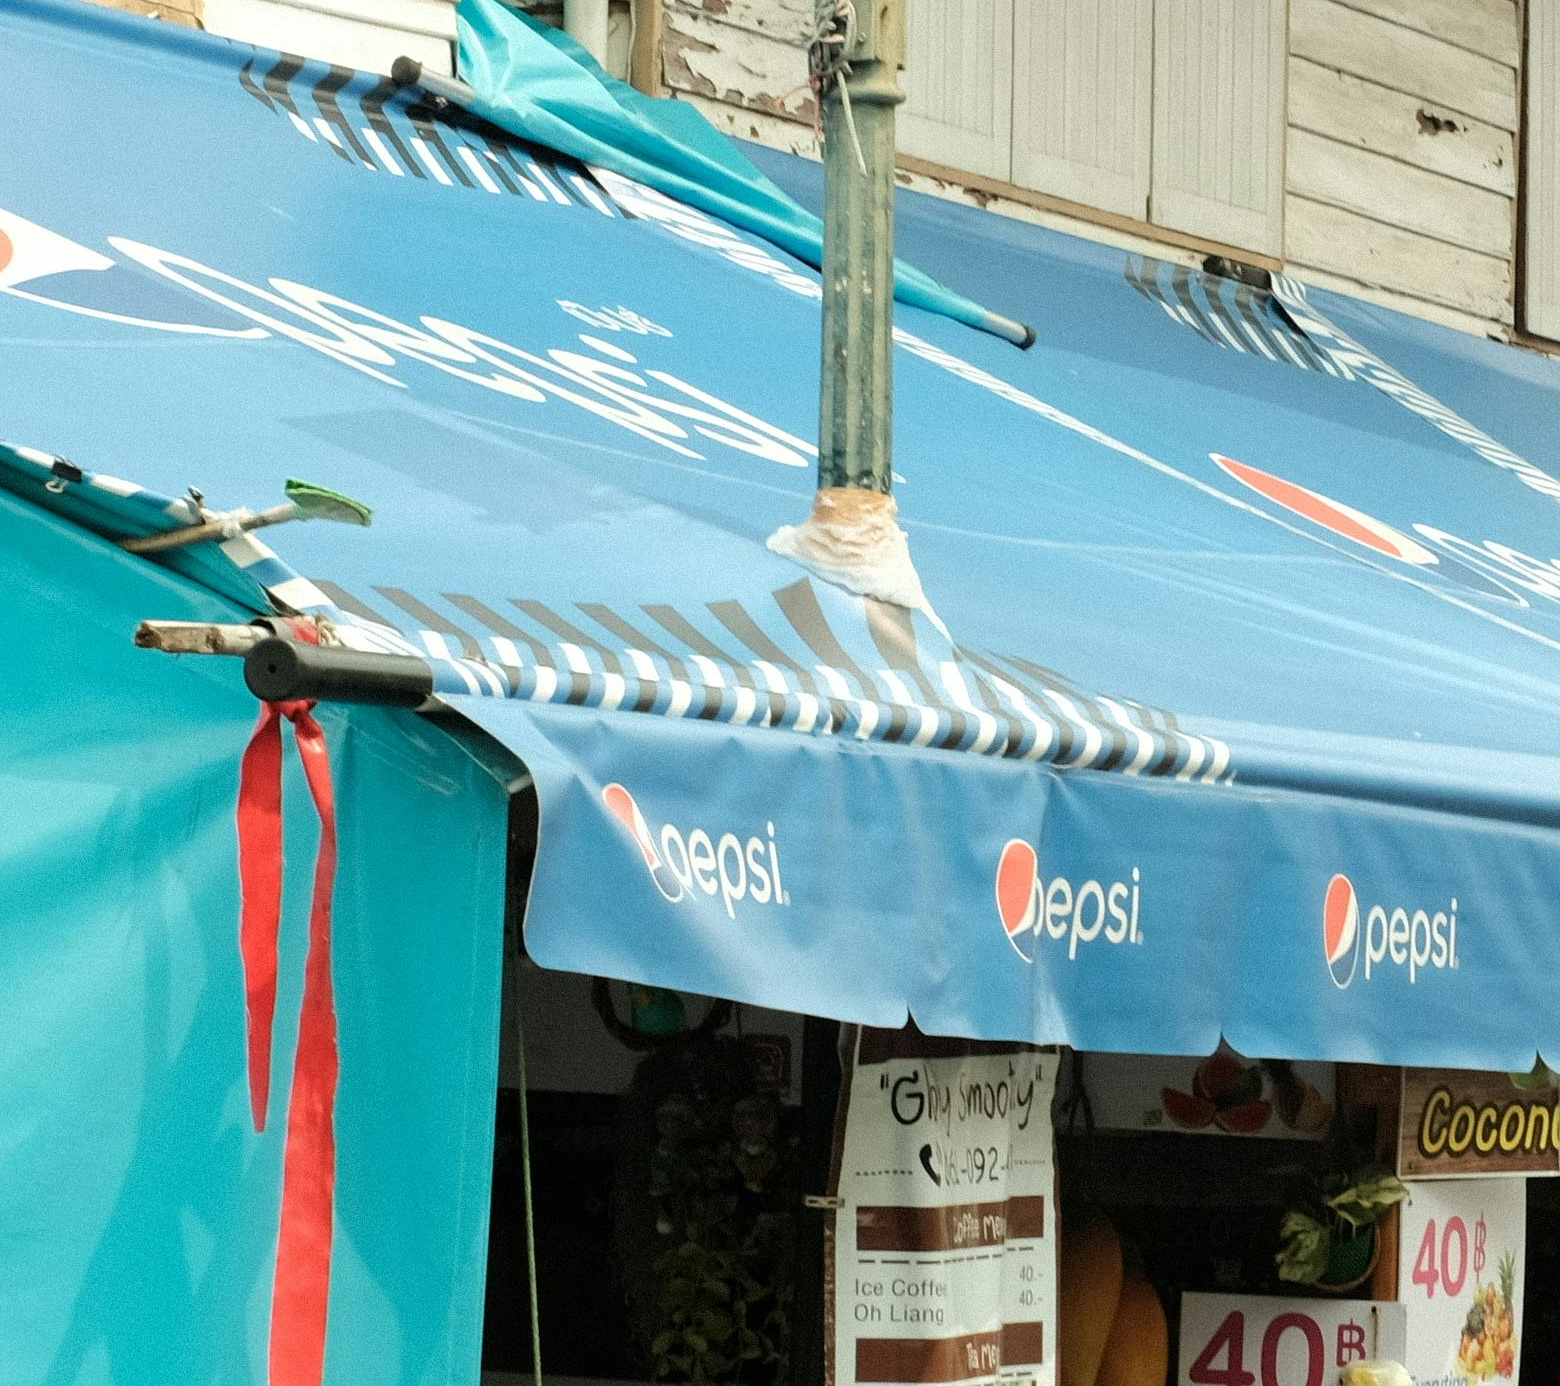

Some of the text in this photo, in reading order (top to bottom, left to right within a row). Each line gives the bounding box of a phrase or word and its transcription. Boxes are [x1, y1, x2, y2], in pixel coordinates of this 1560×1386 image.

[1364, 897, 1459, 985] pepsi
[1411, 1214, 1469, 1300] 40
[853, 1303, 882, 1323] Oh
[889, 1303, 945, 1326] Liang
[854, 1278, 884, 1297] Ice
